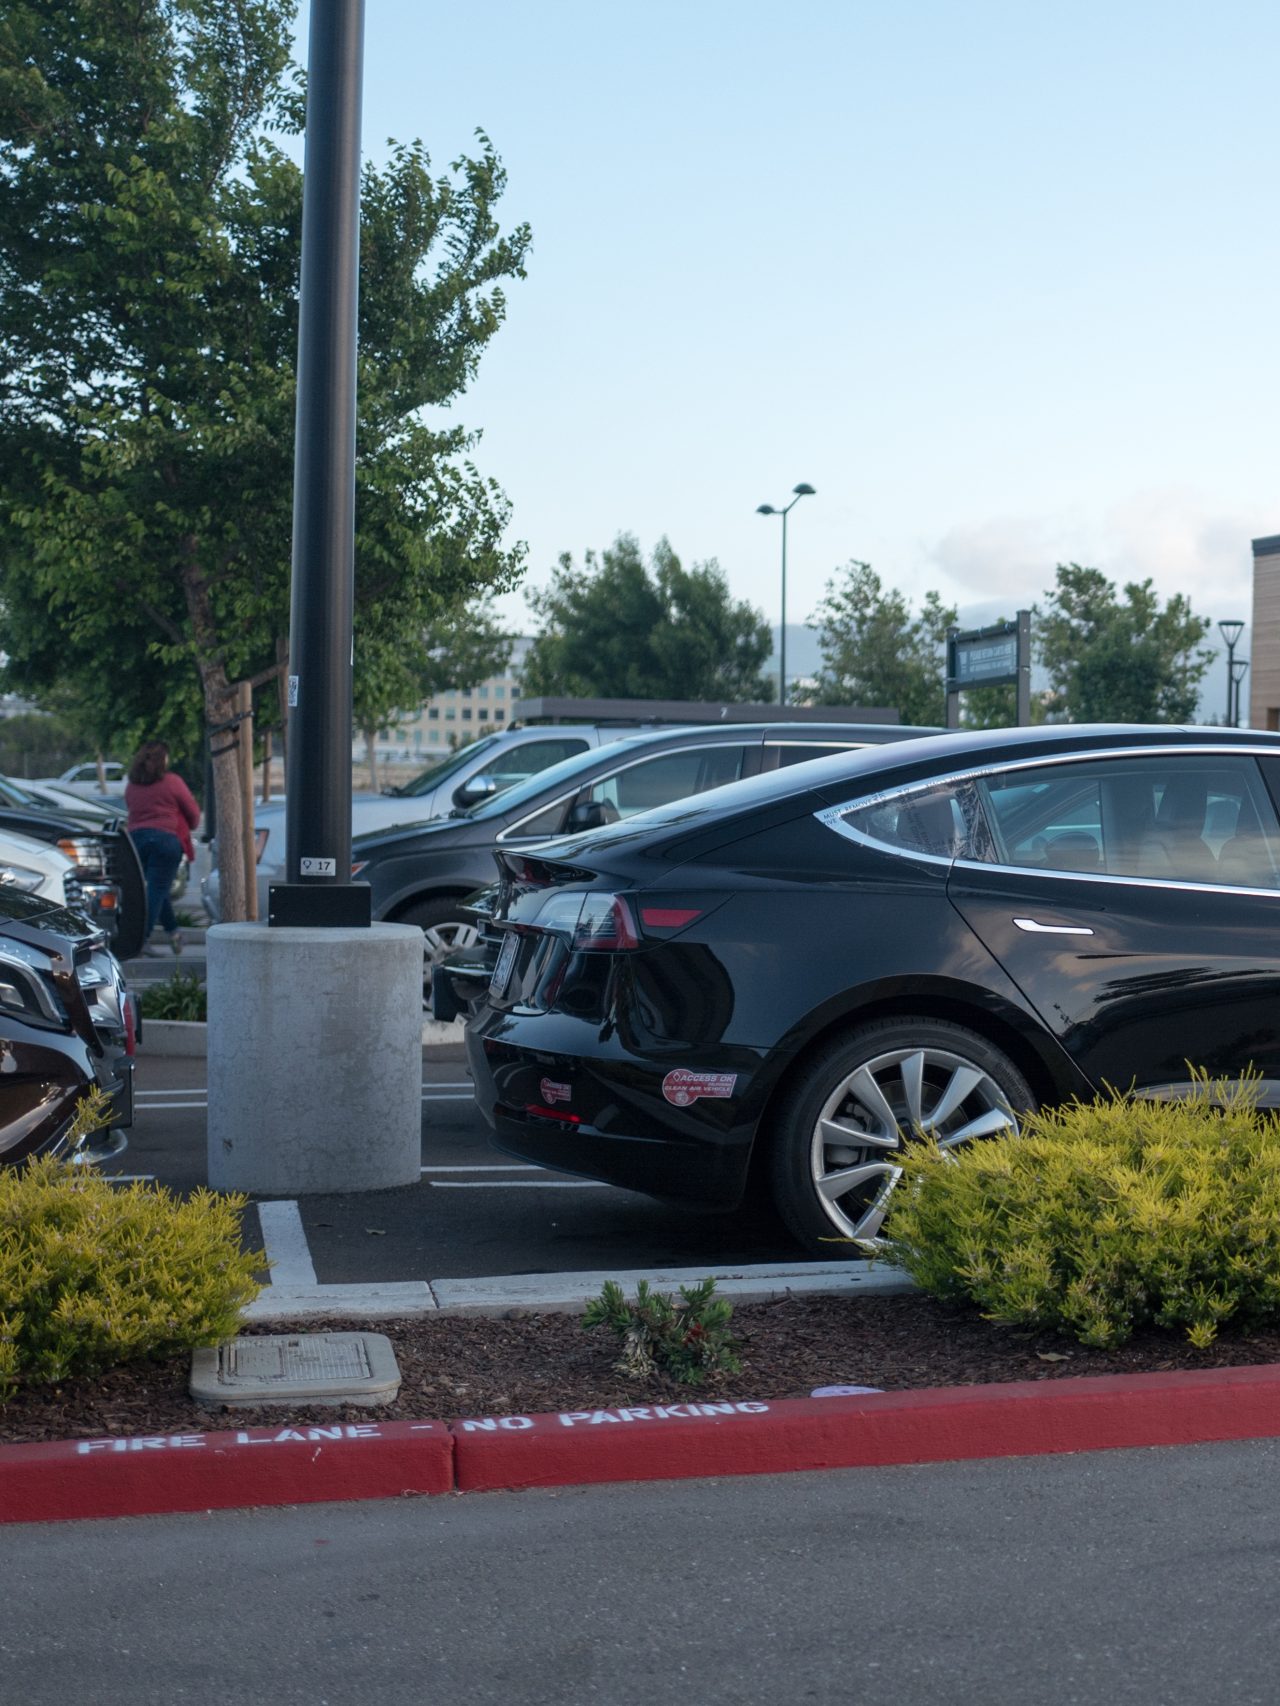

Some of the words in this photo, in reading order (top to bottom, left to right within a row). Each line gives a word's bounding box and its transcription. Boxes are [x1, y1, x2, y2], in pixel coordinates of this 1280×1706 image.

[318, 861, 331, 871] 17
[77, 1434, 206, 1454] FIRE
[237, 1424, 382, 1444] LANE
[463, 1415, 535, 1432] NO
[559, 1401, 770, 1427] PARKING
